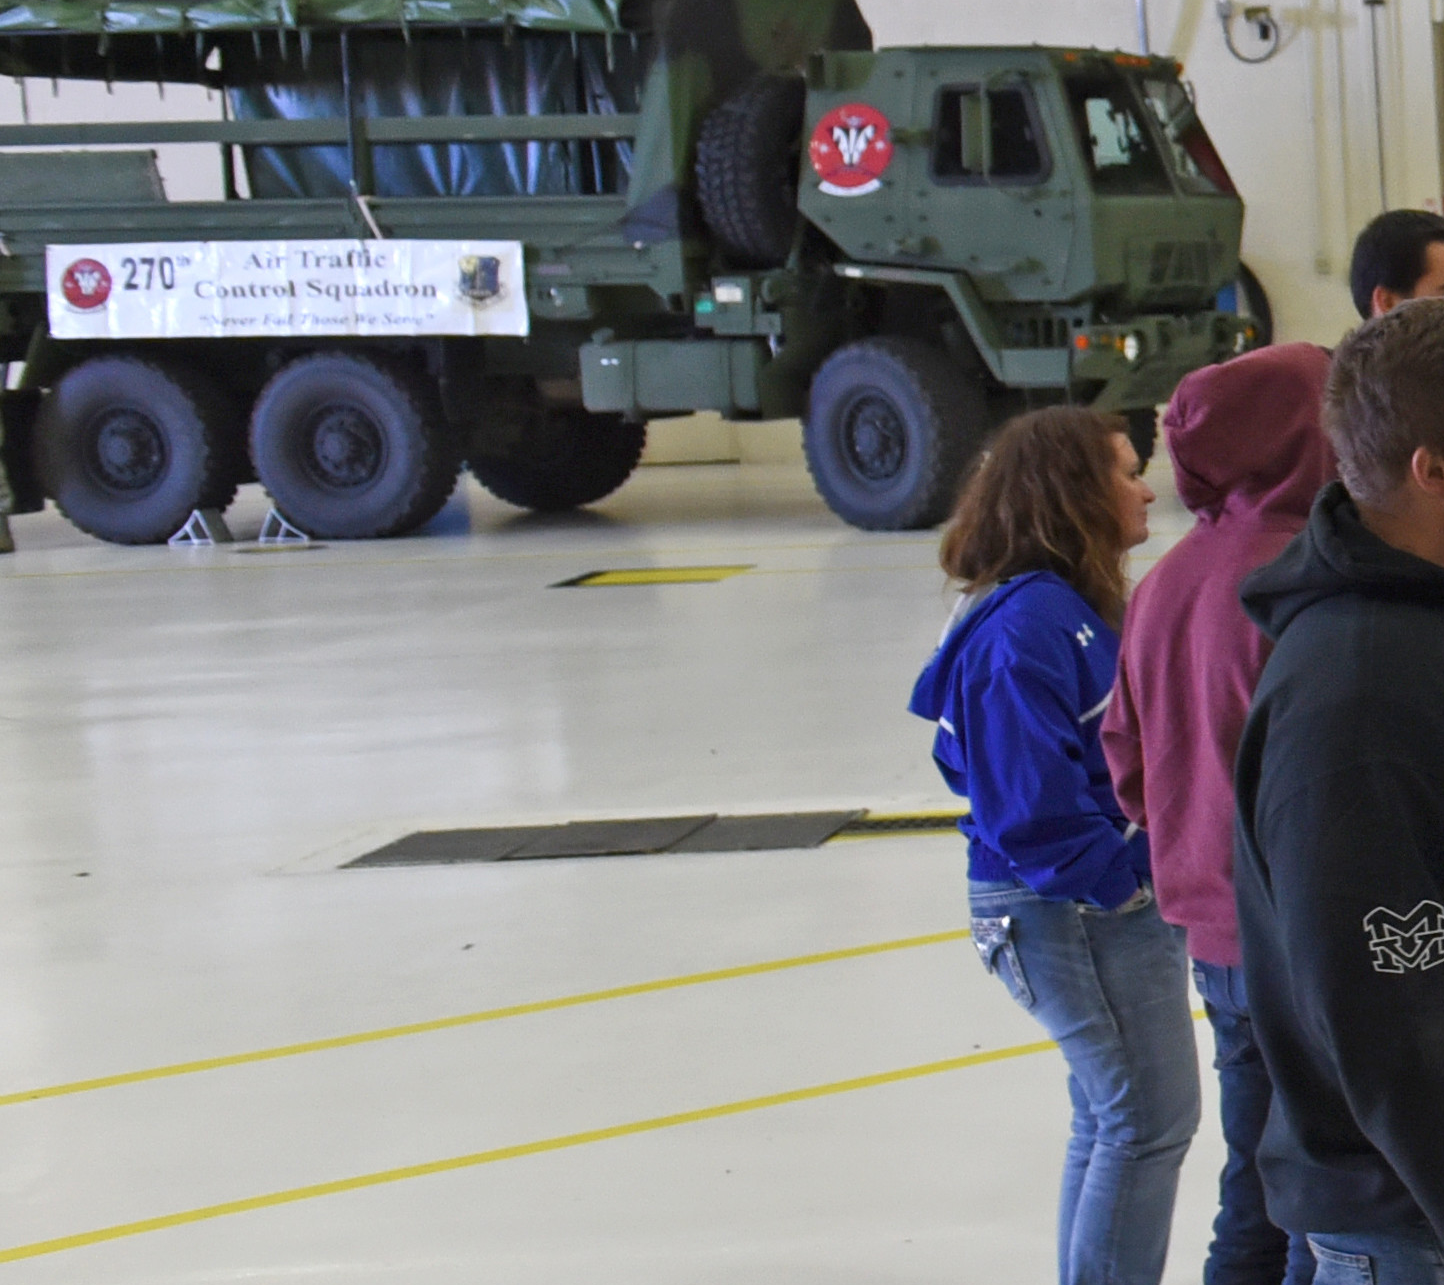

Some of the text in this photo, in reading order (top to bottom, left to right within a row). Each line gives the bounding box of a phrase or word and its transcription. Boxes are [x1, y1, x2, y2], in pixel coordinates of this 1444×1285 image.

[244, 248, 386, 270] Air Traffic
[193, 279, 438, 301] Control Squadron
